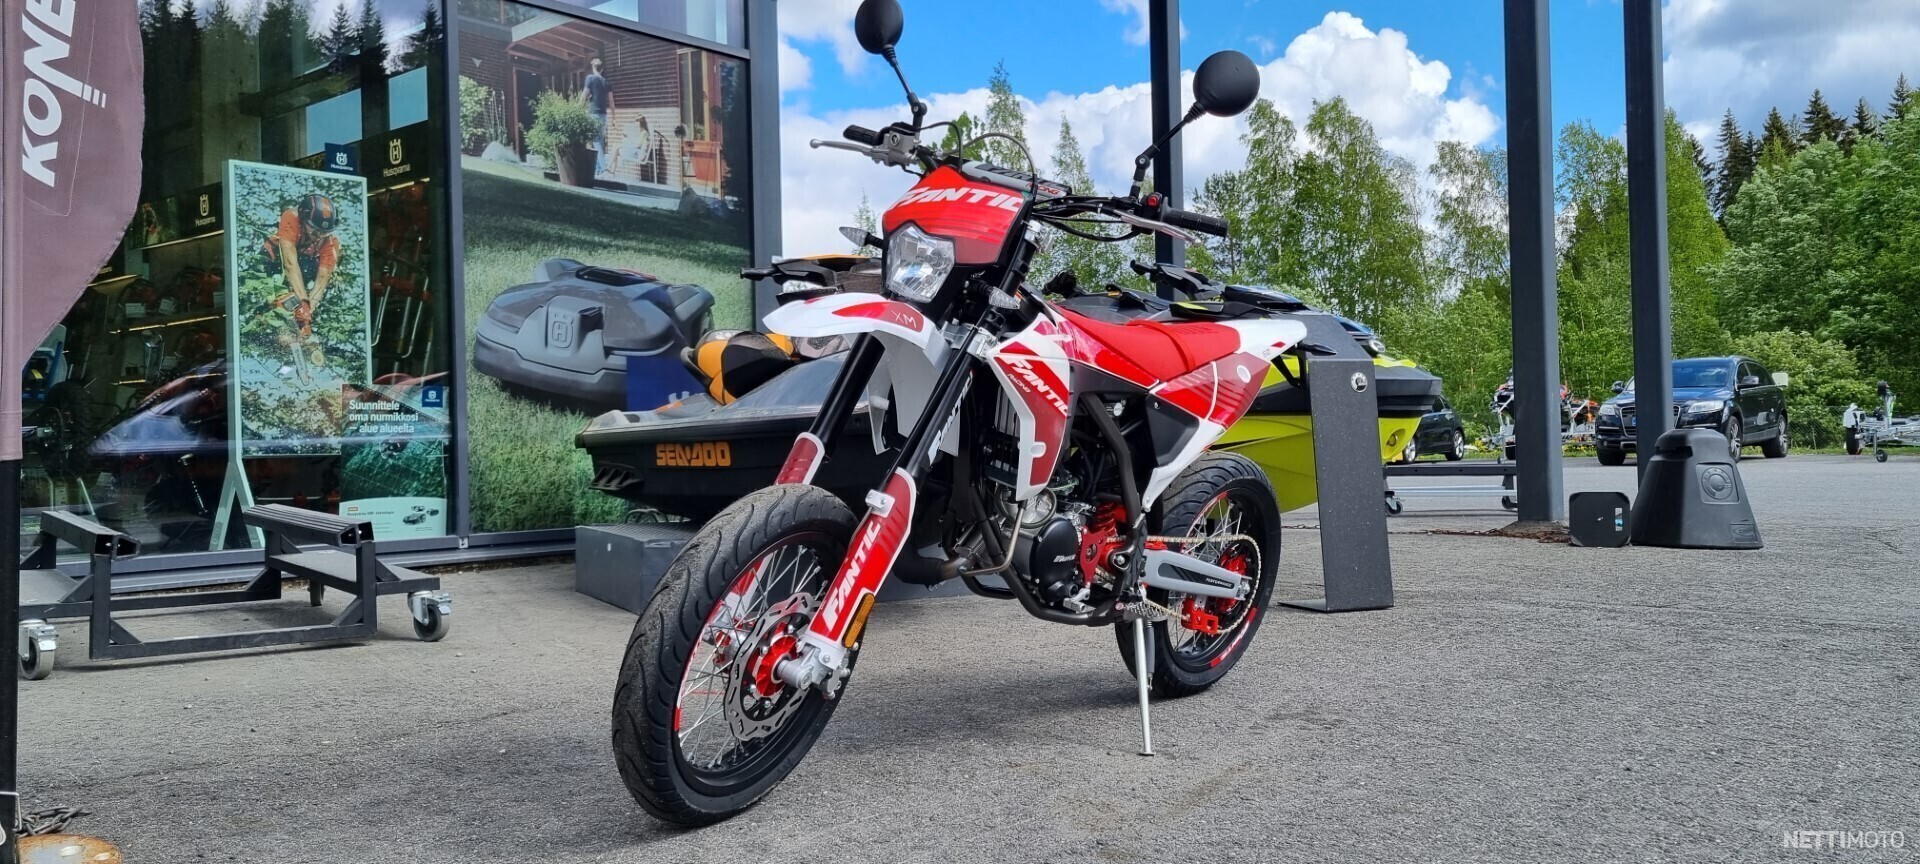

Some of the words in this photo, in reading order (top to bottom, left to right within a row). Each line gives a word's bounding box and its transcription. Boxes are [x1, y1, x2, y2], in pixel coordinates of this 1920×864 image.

[896, 186, 1025, 213] FANTIC
[891, 310, 917, 329] XM
[1001, 357, 1069, 417] FANTIC
[350, 400, 400, 410] Suunnittele
[349, 413, 369, 422] oma
[370, 411, 419, 422] nurmikkosi
[359, 423, 378, 433] alue
[380, 424, 415, 433] alueelta
[822, 520, 881, 633] FANTIC
